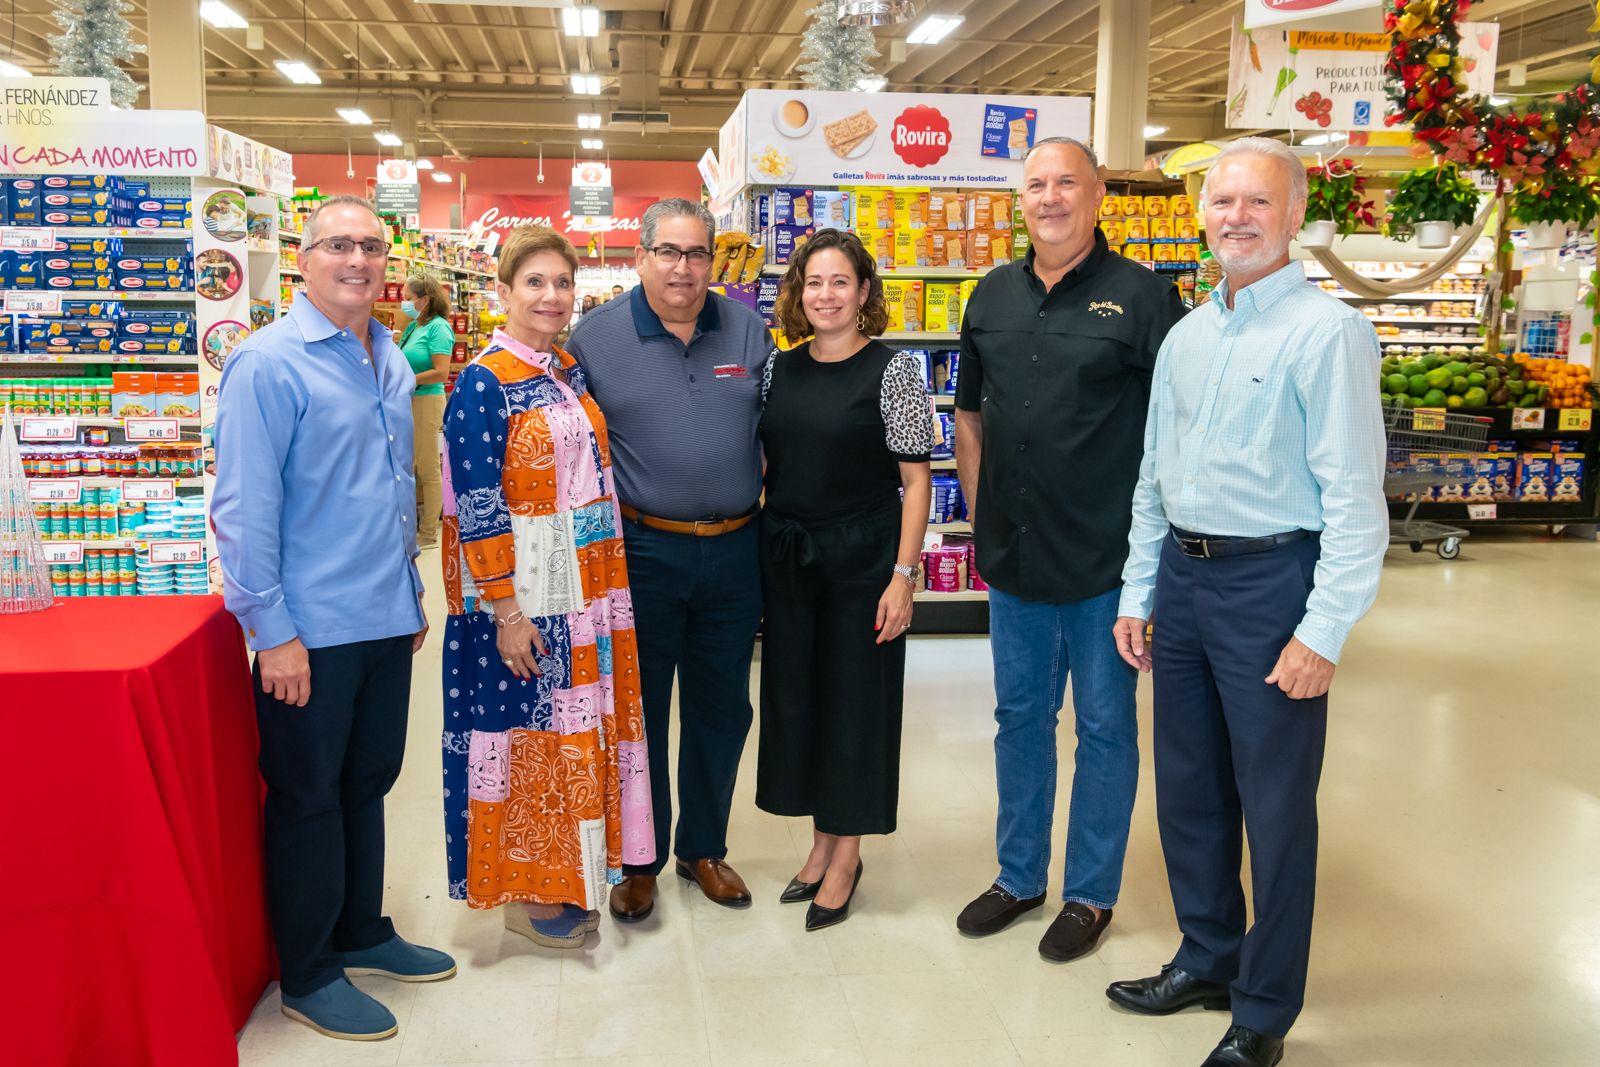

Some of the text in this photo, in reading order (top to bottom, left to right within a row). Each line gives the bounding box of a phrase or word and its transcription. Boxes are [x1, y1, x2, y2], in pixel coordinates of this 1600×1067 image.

[1316, 65, 1377, 79] PRODUCTOS
[1330, 81, 1360, 93] PARA
[5, 85, 99, 106] FERNÁNDEZ
[7, 108, 54, 126] HNOS.
[987, 115, 1007, 123] export
[985, 122, 1004, 130] sodas
[896, 124, 947, 147] Rovira
[13, 146, 89, 167] CADA
[92, 146, 198, 168] MOMENTO
[393, 167, 401, 176] 3
[588, 170, 597, 181] 2
[832, 172, 864, 180] Galletas
[865, 171, 886, 180] Rovira
[906, 173, 941, 182] sabrosas
[942, 175, 947, 183] y
[949, 173, 965, 182] más
[966, 174, 1008, 183] tostaditas!
[479, 207, 553, 230] Carnes
